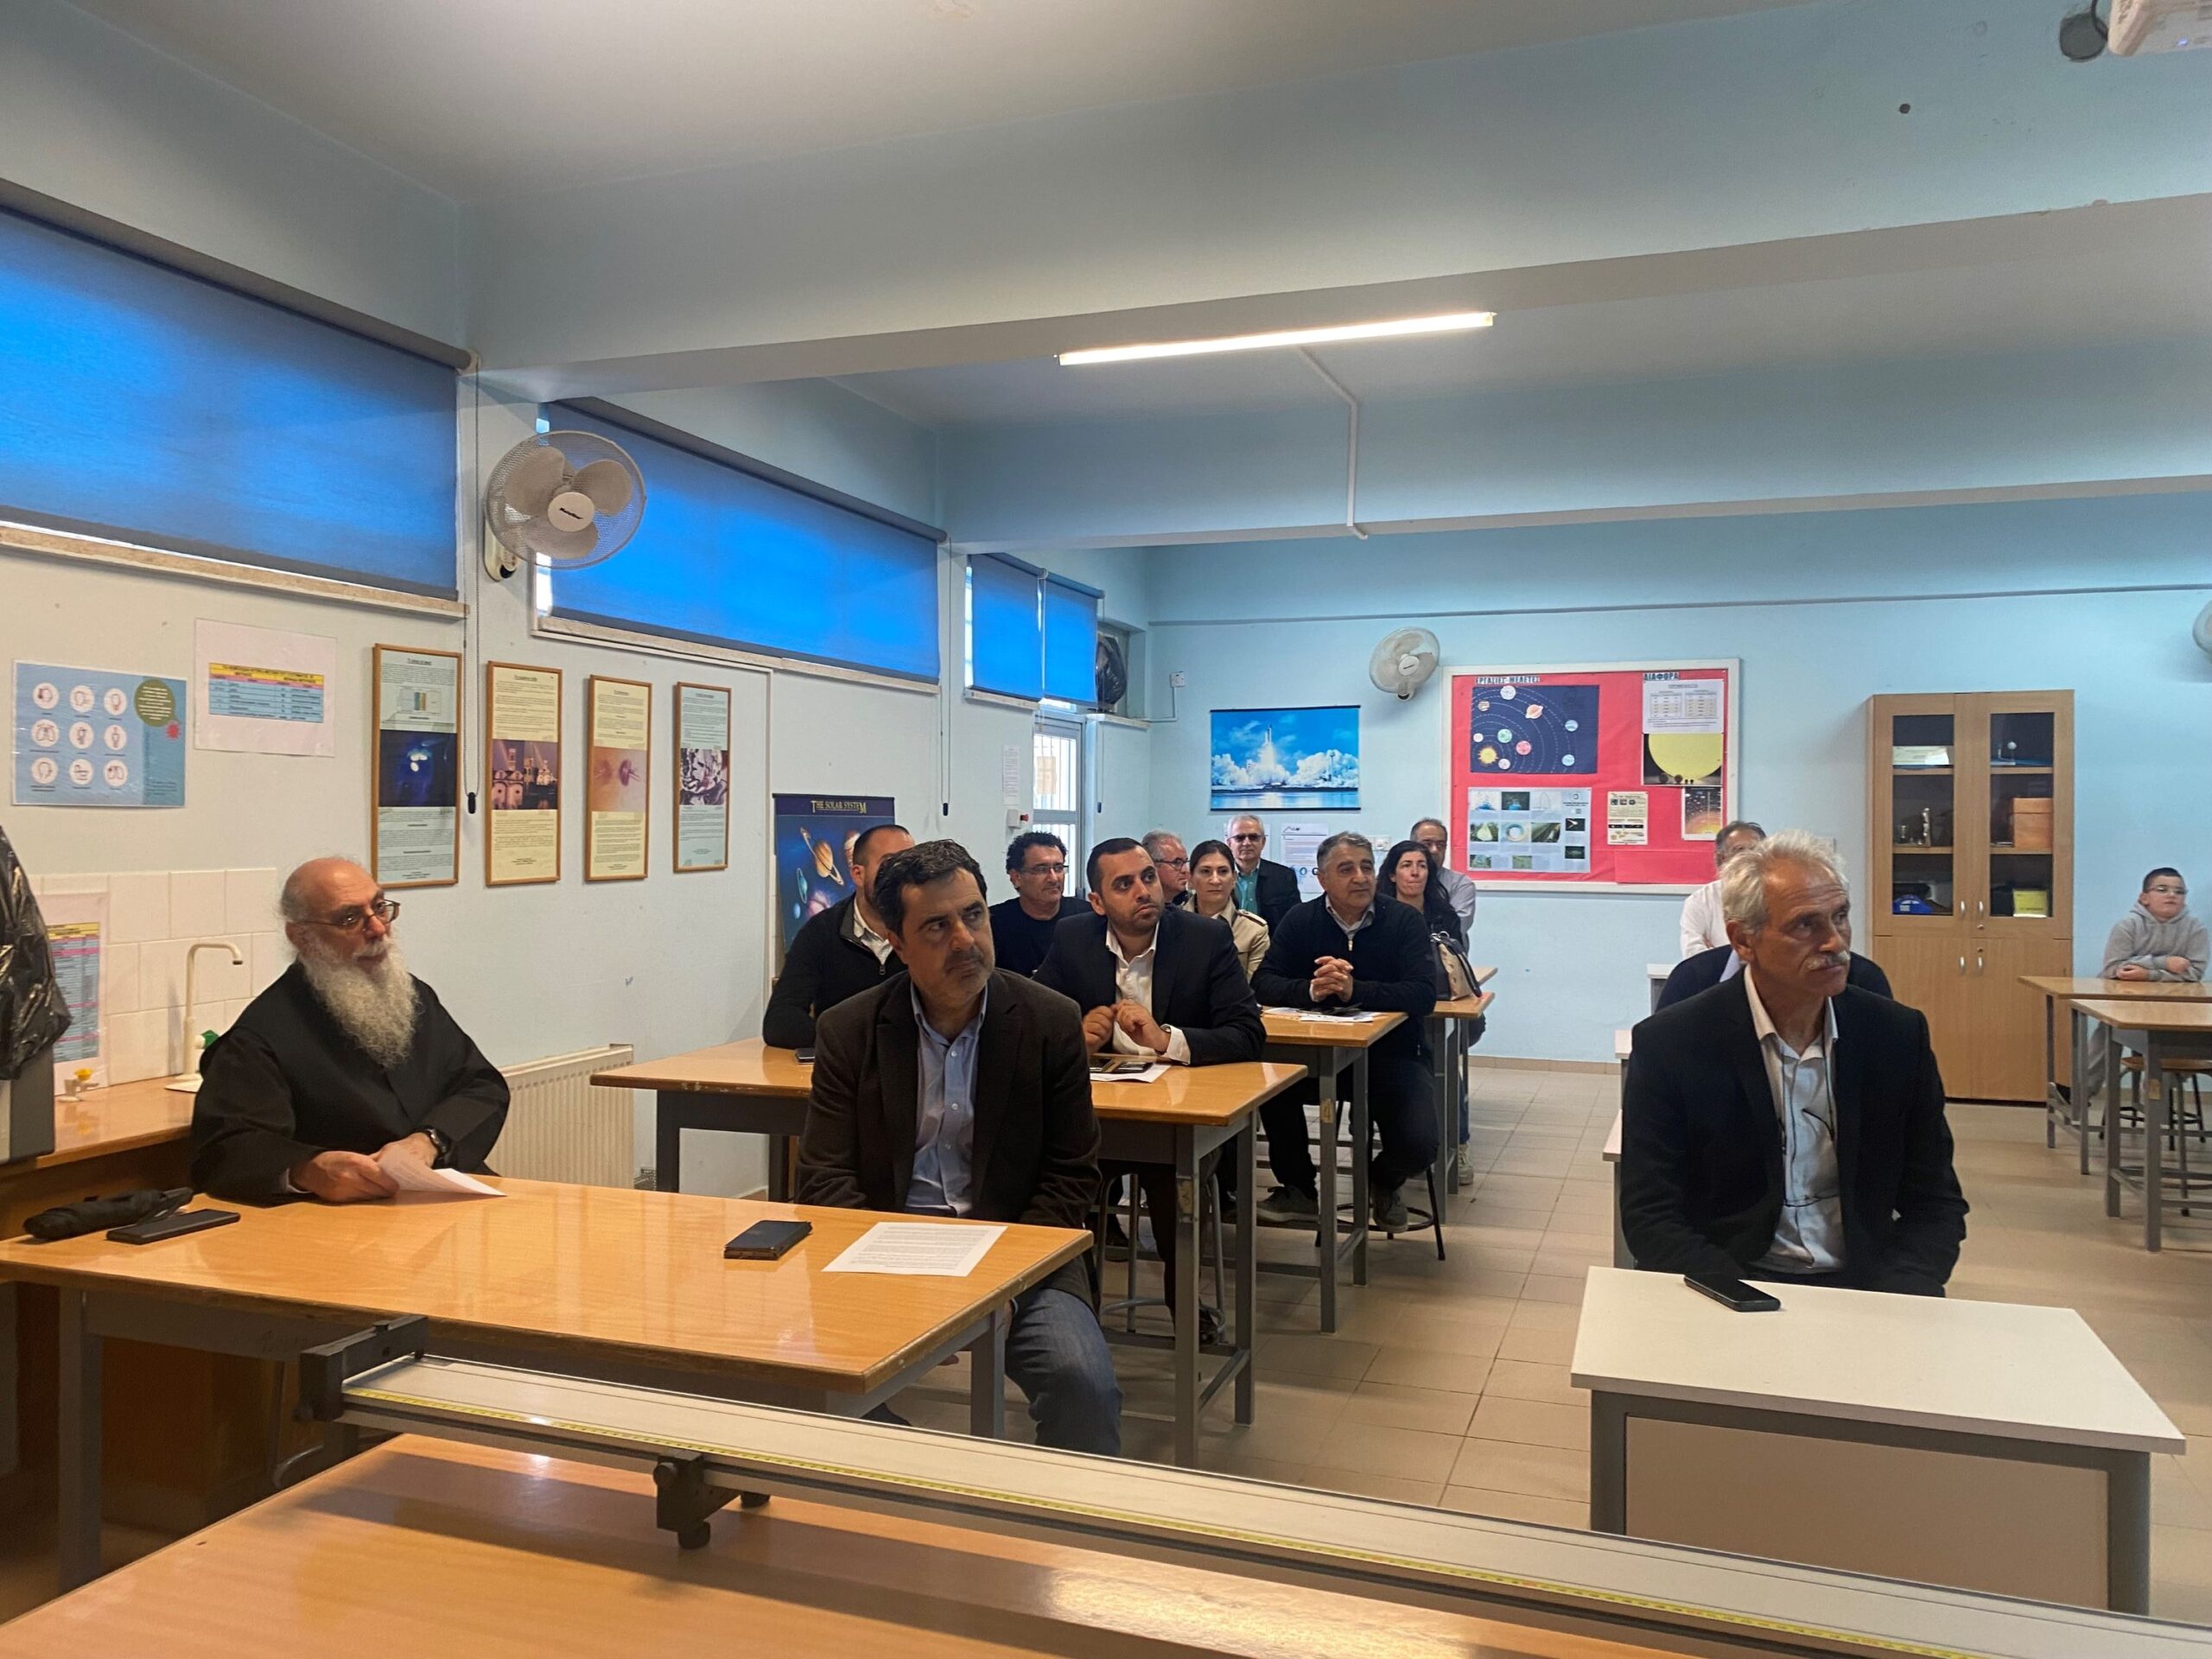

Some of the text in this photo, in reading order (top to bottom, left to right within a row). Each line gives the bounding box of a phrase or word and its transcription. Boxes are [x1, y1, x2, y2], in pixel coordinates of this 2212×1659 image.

[1644, 672, 1678, 681] ΔΙΑΦΟΡΑ
[810, 800, 867, 814] THE SOLAR SYSTEM
